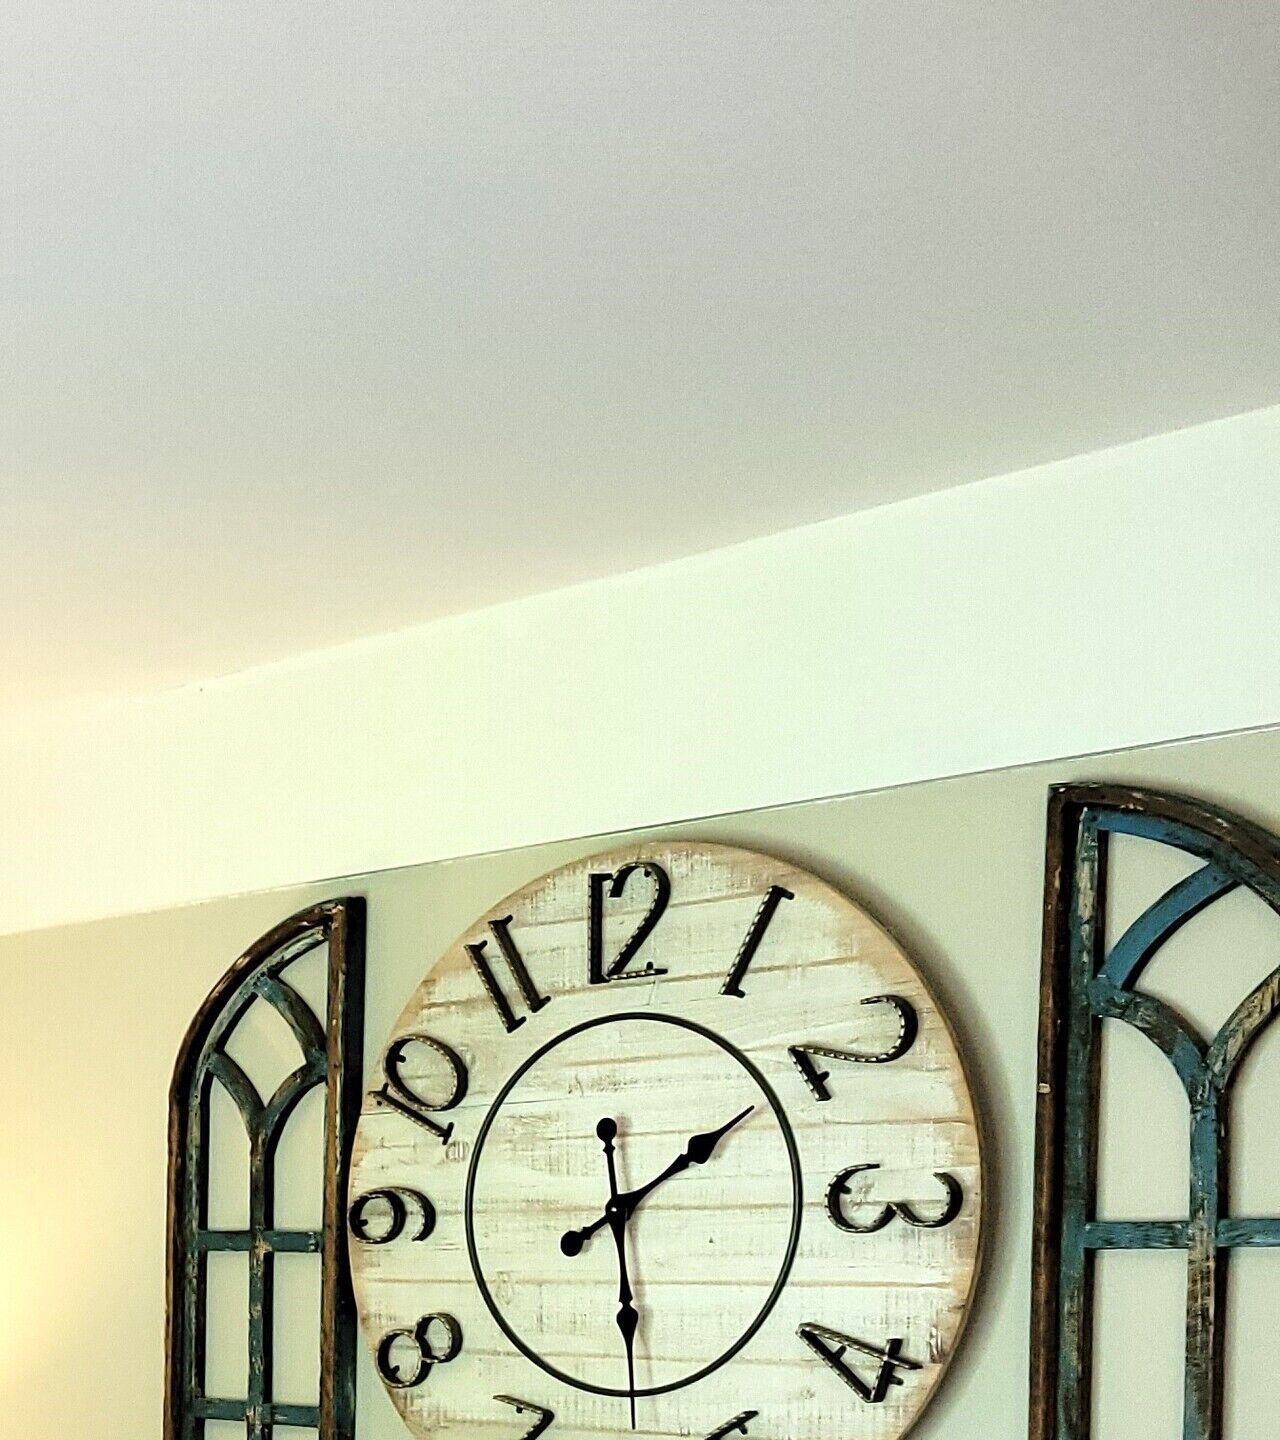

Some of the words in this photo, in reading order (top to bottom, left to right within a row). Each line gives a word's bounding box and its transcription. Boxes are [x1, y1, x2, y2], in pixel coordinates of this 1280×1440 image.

[464, 915, 551, 1033] 11
[588, 861, 671, 985] 12
[721, 885, 794, 998] 1
[368, 1034, 469, 1145] 10
[788, 994, 919, 1102] 2
[348, 1185, 437, 1244] 9
[824, 1162, 963, 1234] 3
[376, 1313, 463, 1389] 8
[796, 1322, 924, 1403] 4
